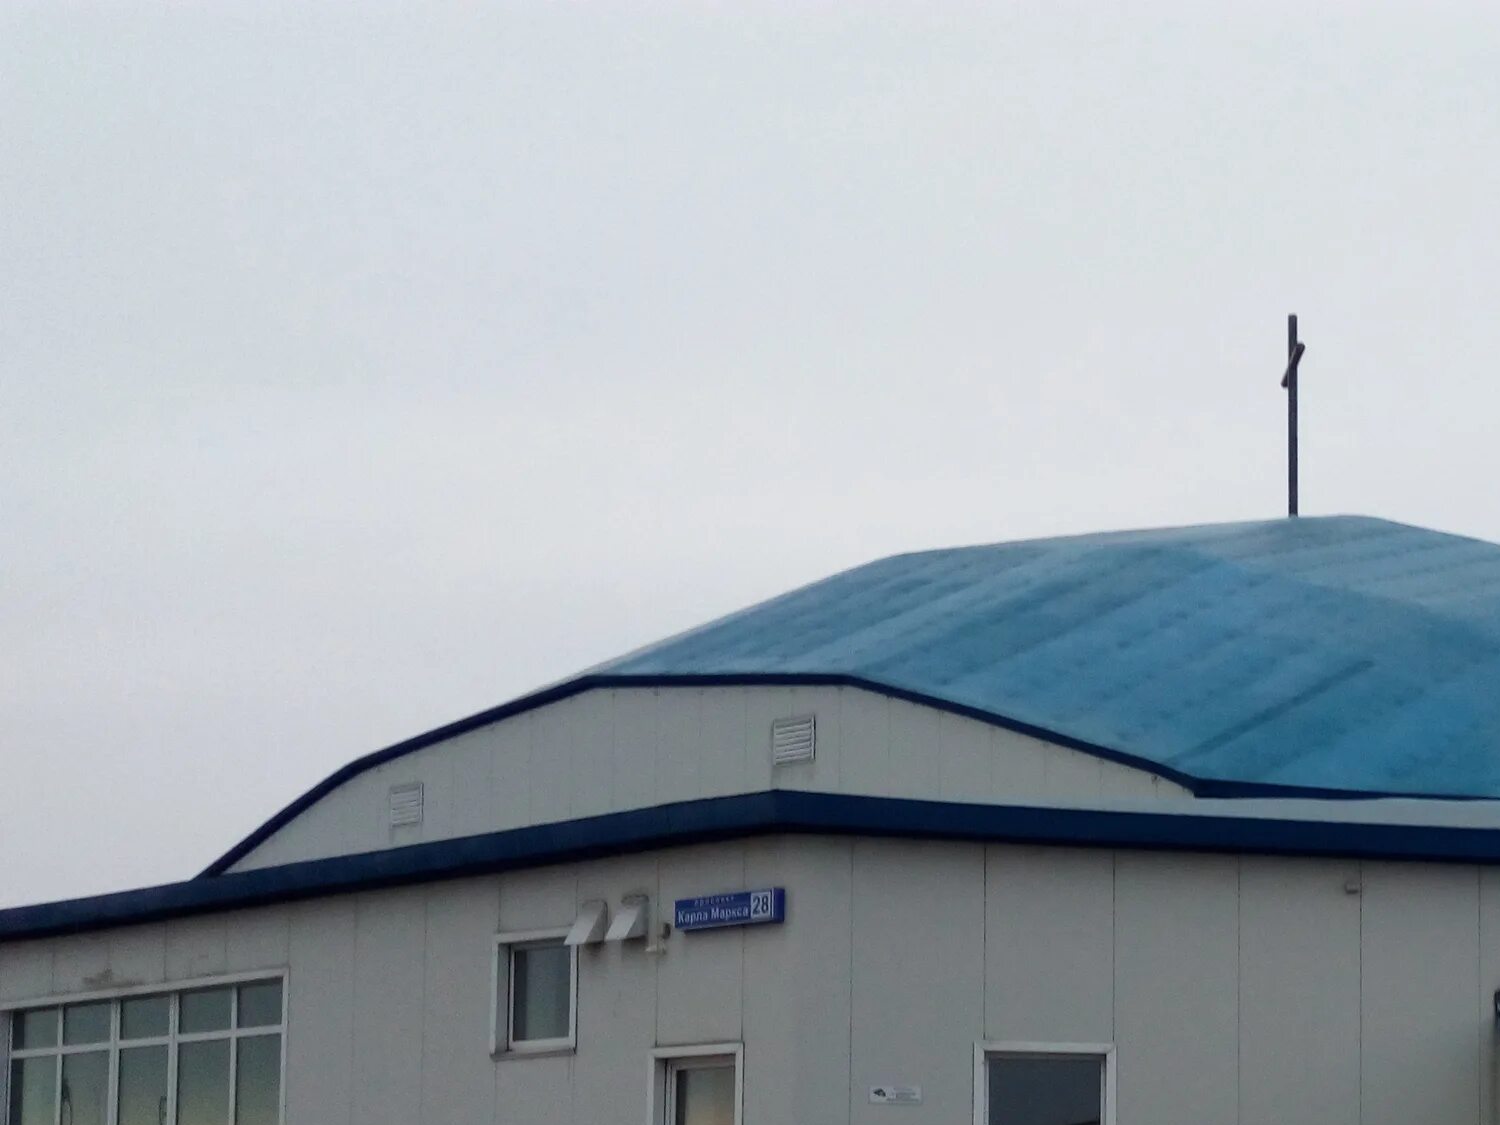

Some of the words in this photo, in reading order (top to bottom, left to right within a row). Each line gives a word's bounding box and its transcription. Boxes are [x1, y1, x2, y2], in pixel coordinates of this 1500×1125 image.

[752, 895, 769, 915] 28
[677, 910, 708, 925] Карла
[711, 906, 749, 921] Маркса
